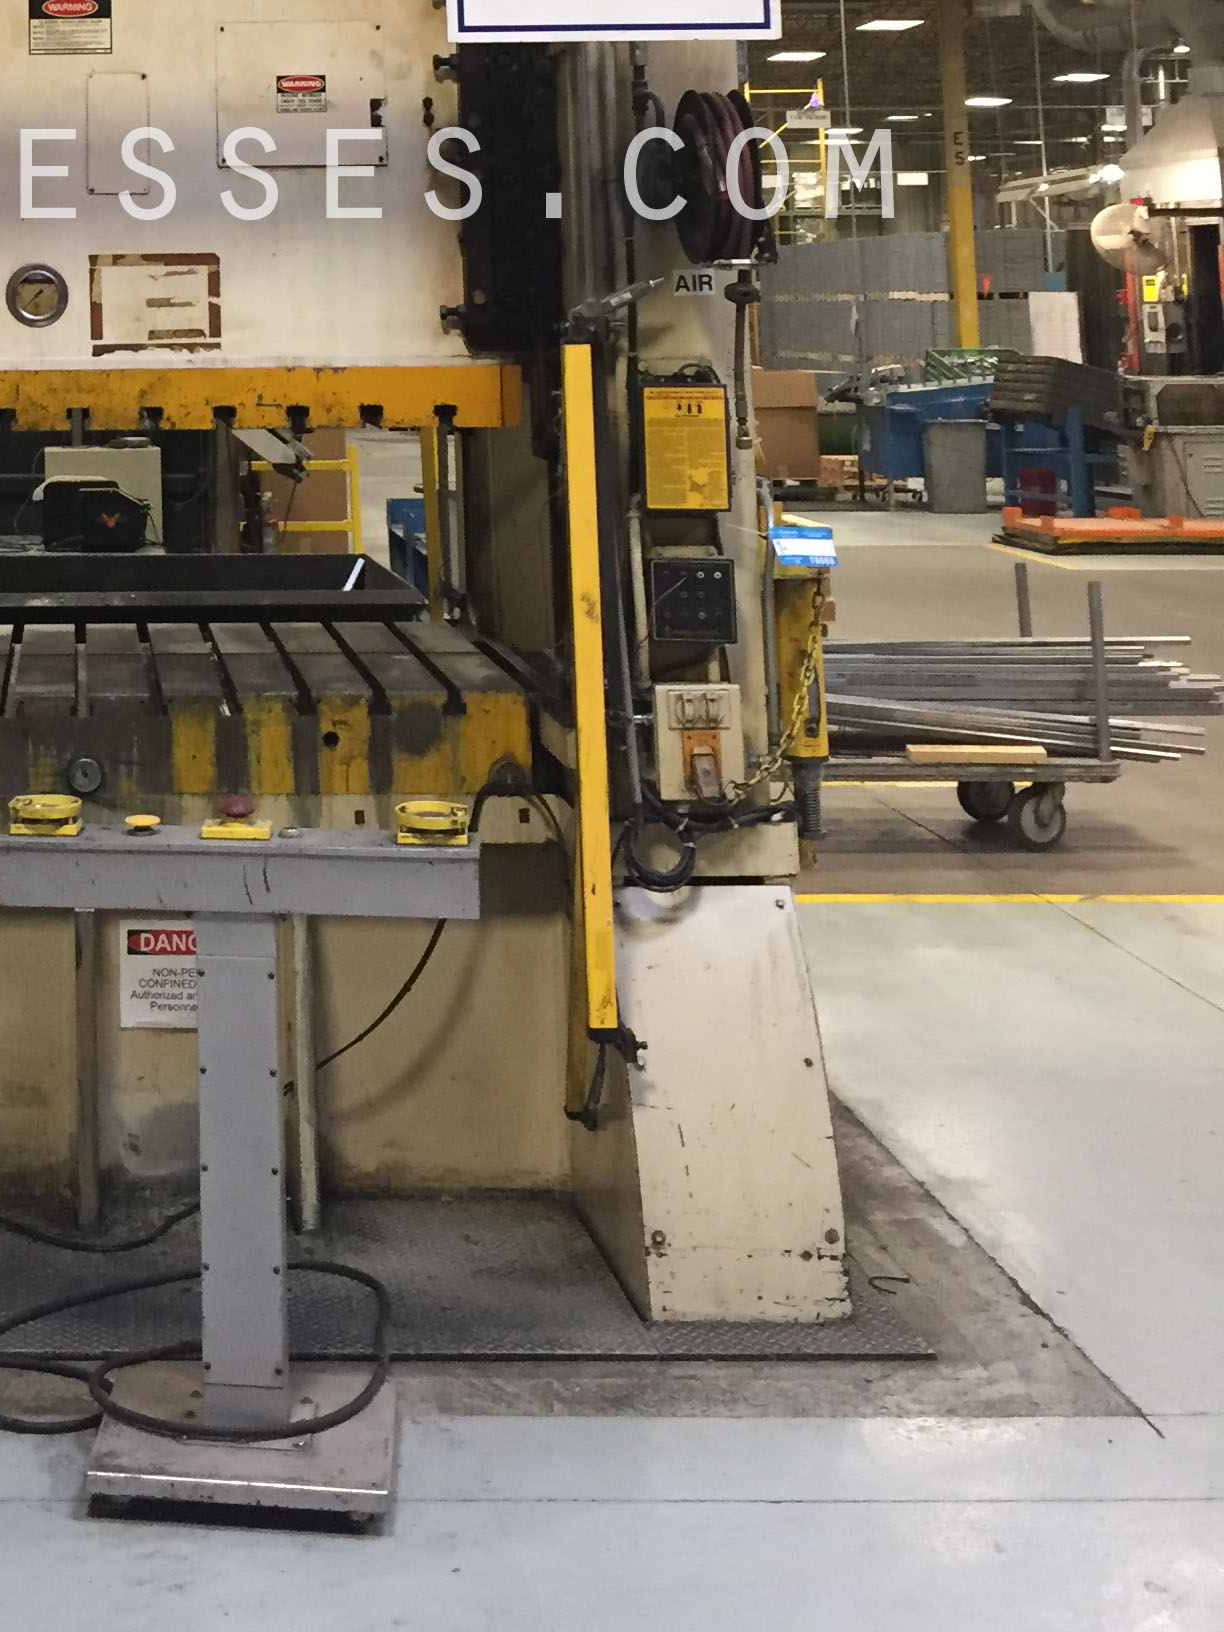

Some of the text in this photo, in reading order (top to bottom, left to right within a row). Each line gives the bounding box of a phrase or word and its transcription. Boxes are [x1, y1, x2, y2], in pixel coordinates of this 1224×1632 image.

[47, 2, 93, 12] WARNING
[674, 274, 713, 293] AIR
[152, 968, 196, 977] NON-PE
[139, 978, 197, 988] CONFINED
[131, 990, 184, 1000] Authorized
[150, 1001, 198, 1012] Personne
